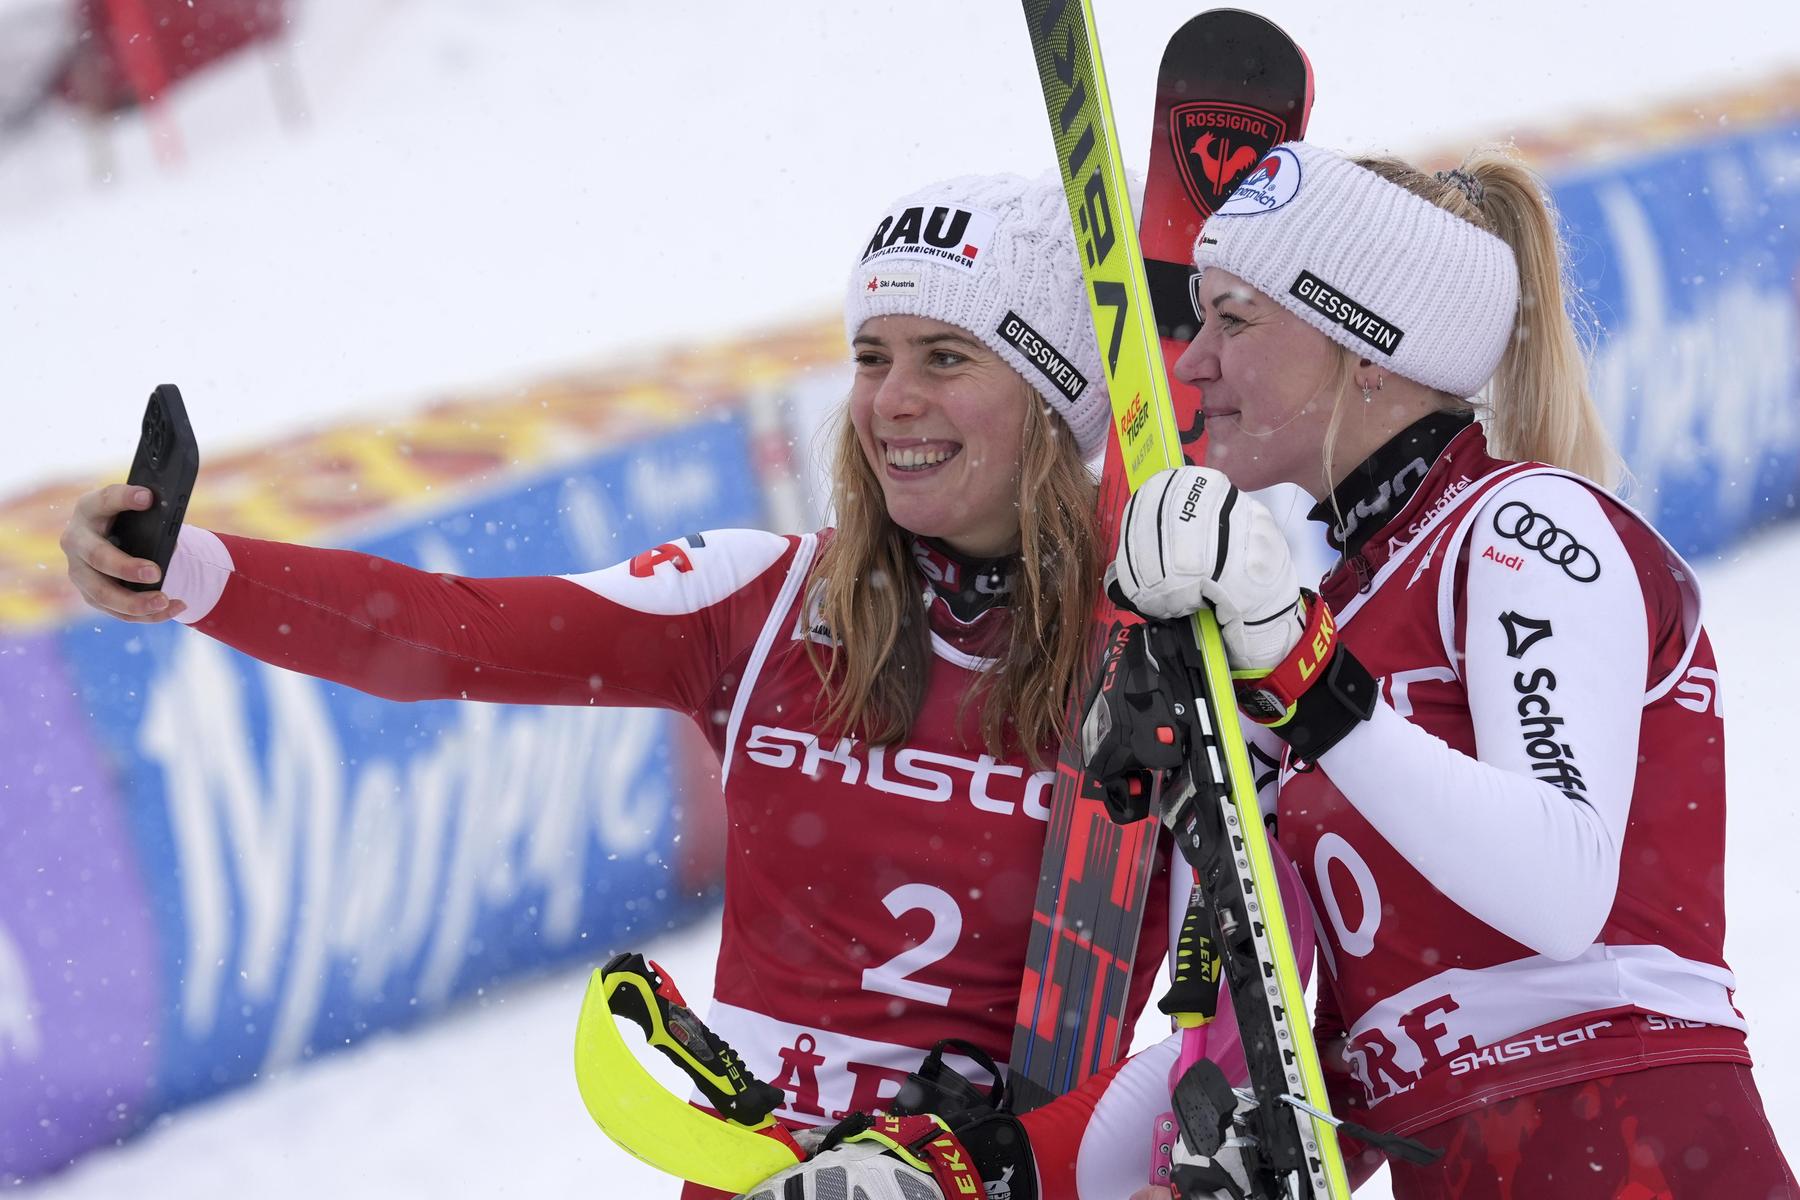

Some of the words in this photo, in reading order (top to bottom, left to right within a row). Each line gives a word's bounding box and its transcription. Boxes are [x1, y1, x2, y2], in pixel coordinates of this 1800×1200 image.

[1185, 112, 1269, 140] ROSSIGNOL
[879, 280, 890, 288] Ski
[890, 280, 915, 288] Austria
[1297, 276, 1398, 349] GIESSWEIN
[1005, 319, 1084, 397] GIESSWEIN
[1120, 391, 1142, 437] RACE
[1126, 402, 1149, 447] TIGER
[1131, 433, 1155, 475] MASTER
[1179, 475, 1208, 523] eusch
[1481, 545, 1525, 572] Audi
[1298, 606, 1334, 682] LEKI
[861, 882, 963, 1008] 2
[1200, 935, 1212, 983] LEKI
[718, 1049, 748, 1093] LEKI
[932, 1138, 980, 1200] EKI
